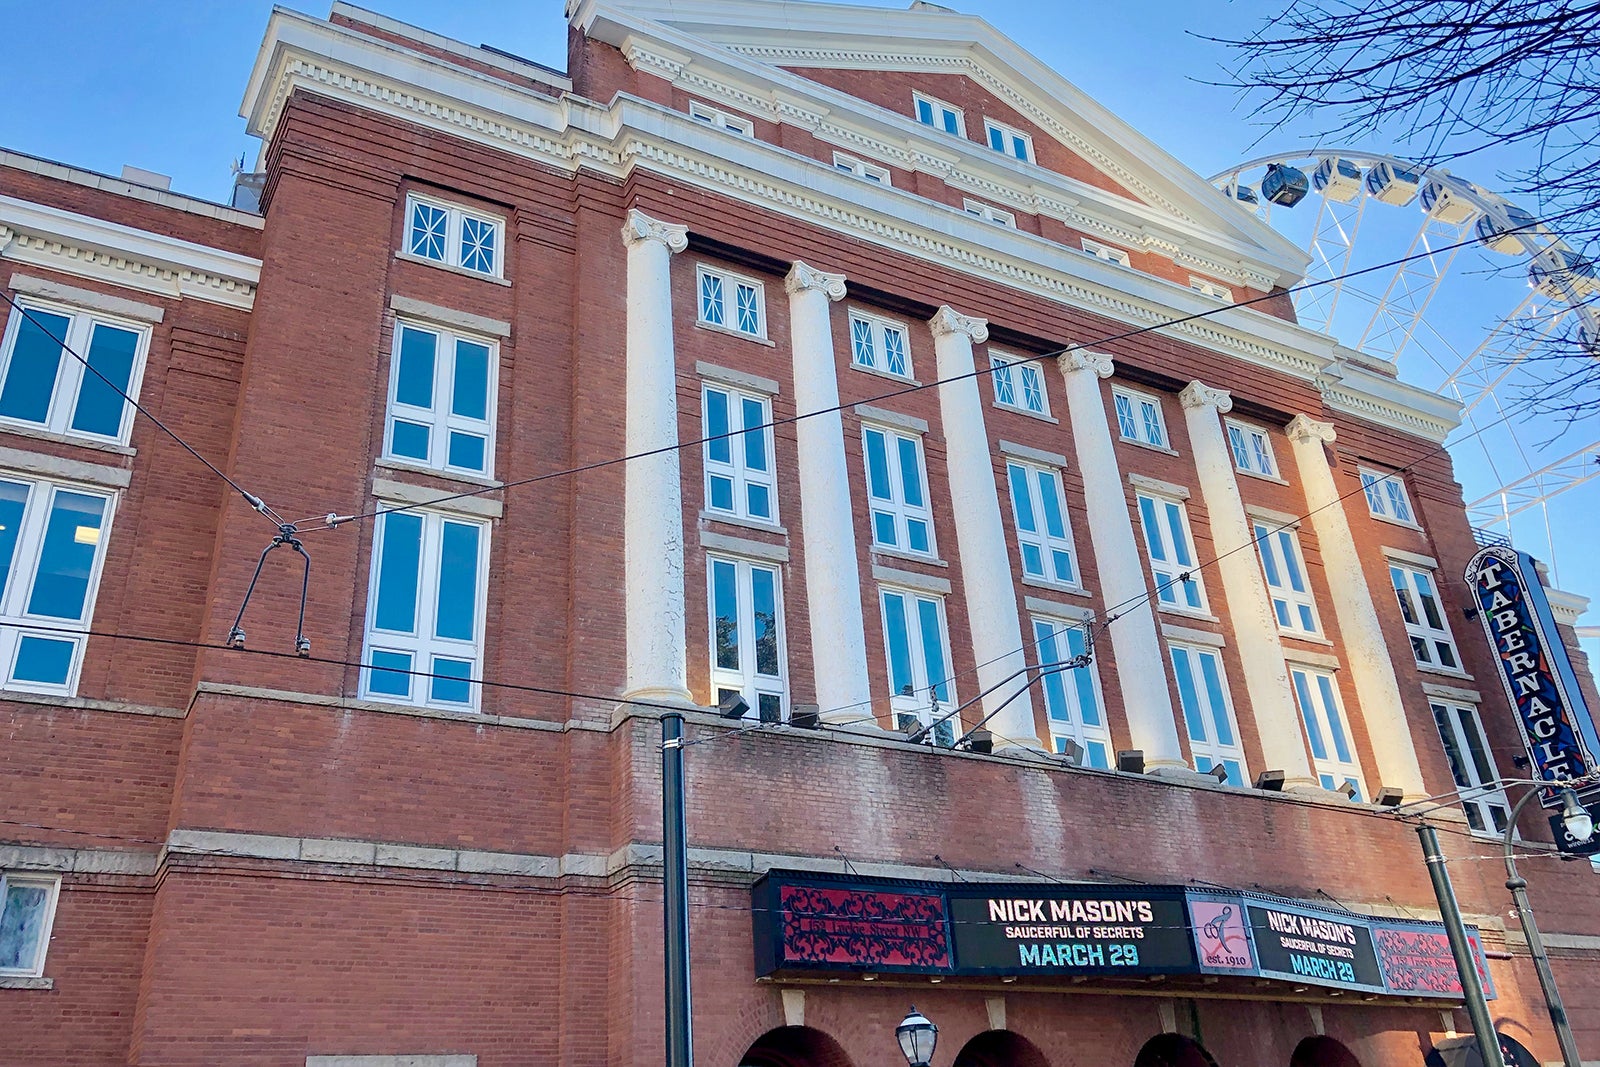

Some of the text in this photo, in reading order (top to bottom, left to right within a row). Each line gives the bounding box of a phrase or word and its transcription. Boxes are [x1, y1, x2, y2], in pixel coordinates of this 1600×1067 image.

[1476, 562, 1574, 784] TABERNACLE
[988, 899, 1154, 923] NICK MASON'S
[833, 922, 865, 935] Luckie
[870, 924, 898, 937] Street
[903, 926, 922, 938] NW
[1005, 926, 1145, 939] SAUCERFUL OF SECRETS
[1267, 910, 1357, 945] NICK MASON'S
[1018, 944, 1140, 967] MARCH 29
[1280, 936, 1355, 959] SAUCERFUL OF SECRETS
[1207, 953, 1247, 967] est. 1910
[1289, 953, 1356, 982] MARCH 29
